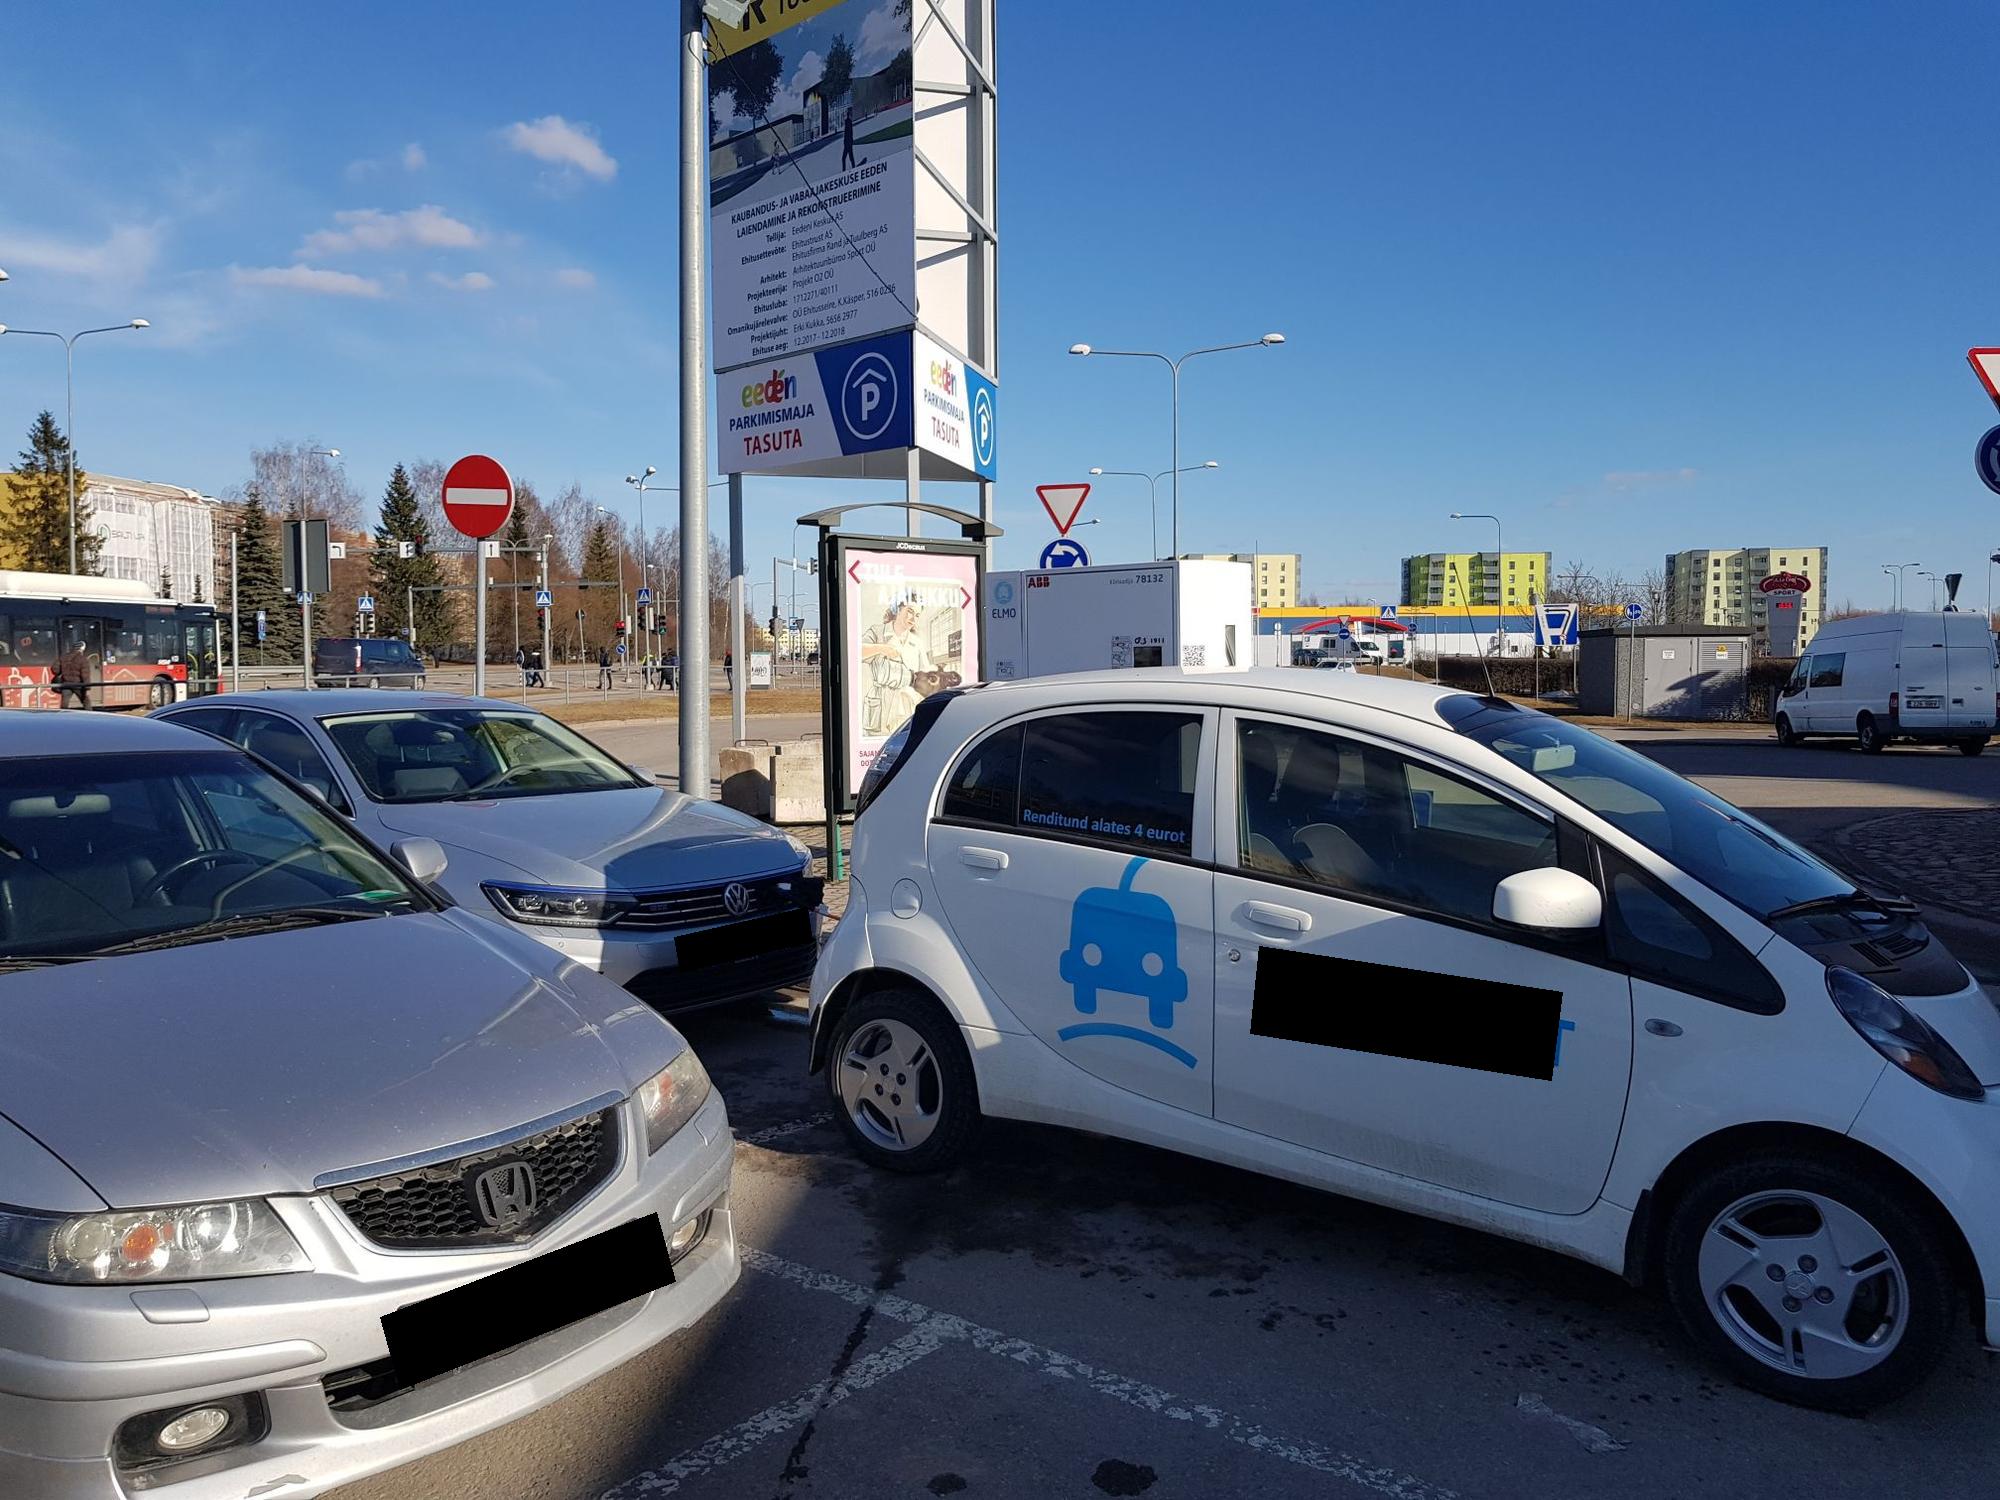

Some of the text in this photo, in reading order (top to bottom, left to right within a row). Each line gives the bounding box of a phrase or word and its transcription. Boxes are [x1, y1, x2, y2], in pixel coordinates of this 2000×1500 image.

[780, 197, 788, 209] JA
[861, 162, 887, 180] EEDEN
[737, 214, 786, 238] LAIENDAMINE
[788, 210, 796, 224] JA
[766, 232, 786, 244] Tellija:
[836, 211, 844, 222] AS
[824, 230, 833, 240] AS
[879, 224, 888, 234] AS
[760, 271, 788, 285] Arhitekt:
[747, 284, 788, 302] Projekteerija:
[754, 299, 788, 314] Ehitusluba:
[752, 344, 774, 356] Ehituse
[861, 382, 880, 421] P
[924, 388, 964, 424] PARKIMISMAJA
[729, 404, 814, 432] PARKIMISMAJA
[744, 428, 802, 456] TASUTA
[931, 416, 960, 448] TASUTA
[1028, 576, 1050, 588] ABB
[1135, 574, 1163, 584] 78132
[992, 608, 1016, 618] ELMO
[1023, 809, 1186, 843] Renditund alates 4 eurot
